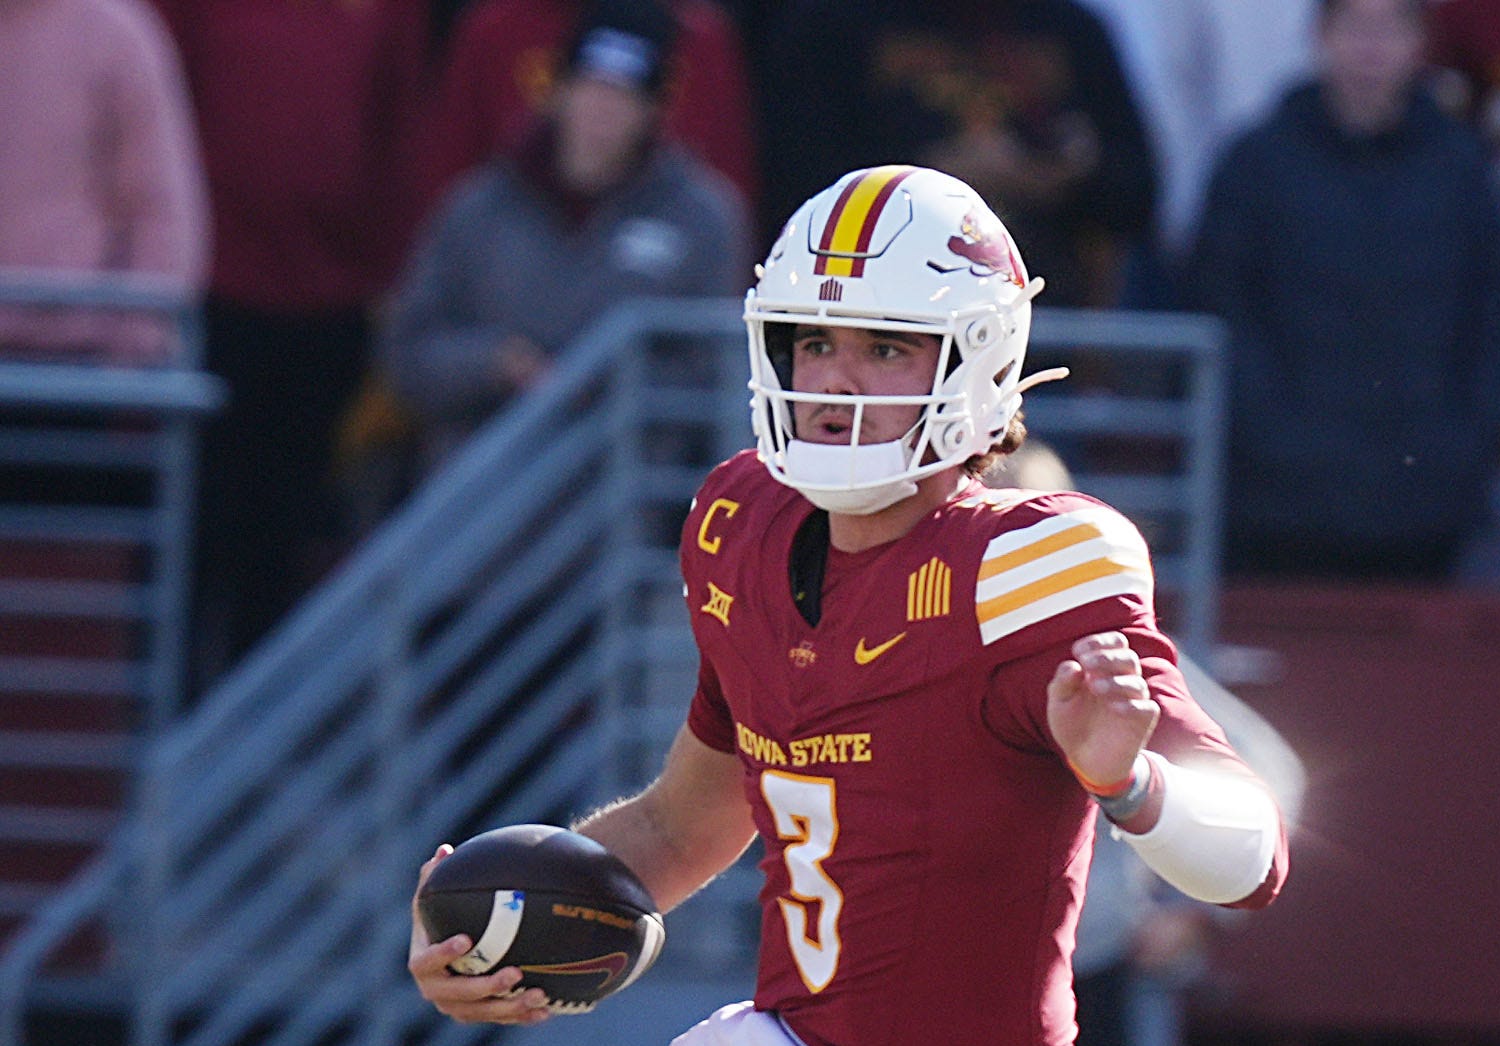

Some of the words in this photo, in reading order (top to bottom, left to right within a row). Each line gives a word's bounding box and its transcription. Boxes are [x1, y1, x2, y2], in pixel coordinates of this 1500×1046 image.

[697, 498, 741, 554] C
[701, 581, 734, 627] XII
[736, 721, 788, 766] IOWA
[788, 733, 873, 767] STATE
[760, 768, 844, 994] 3
